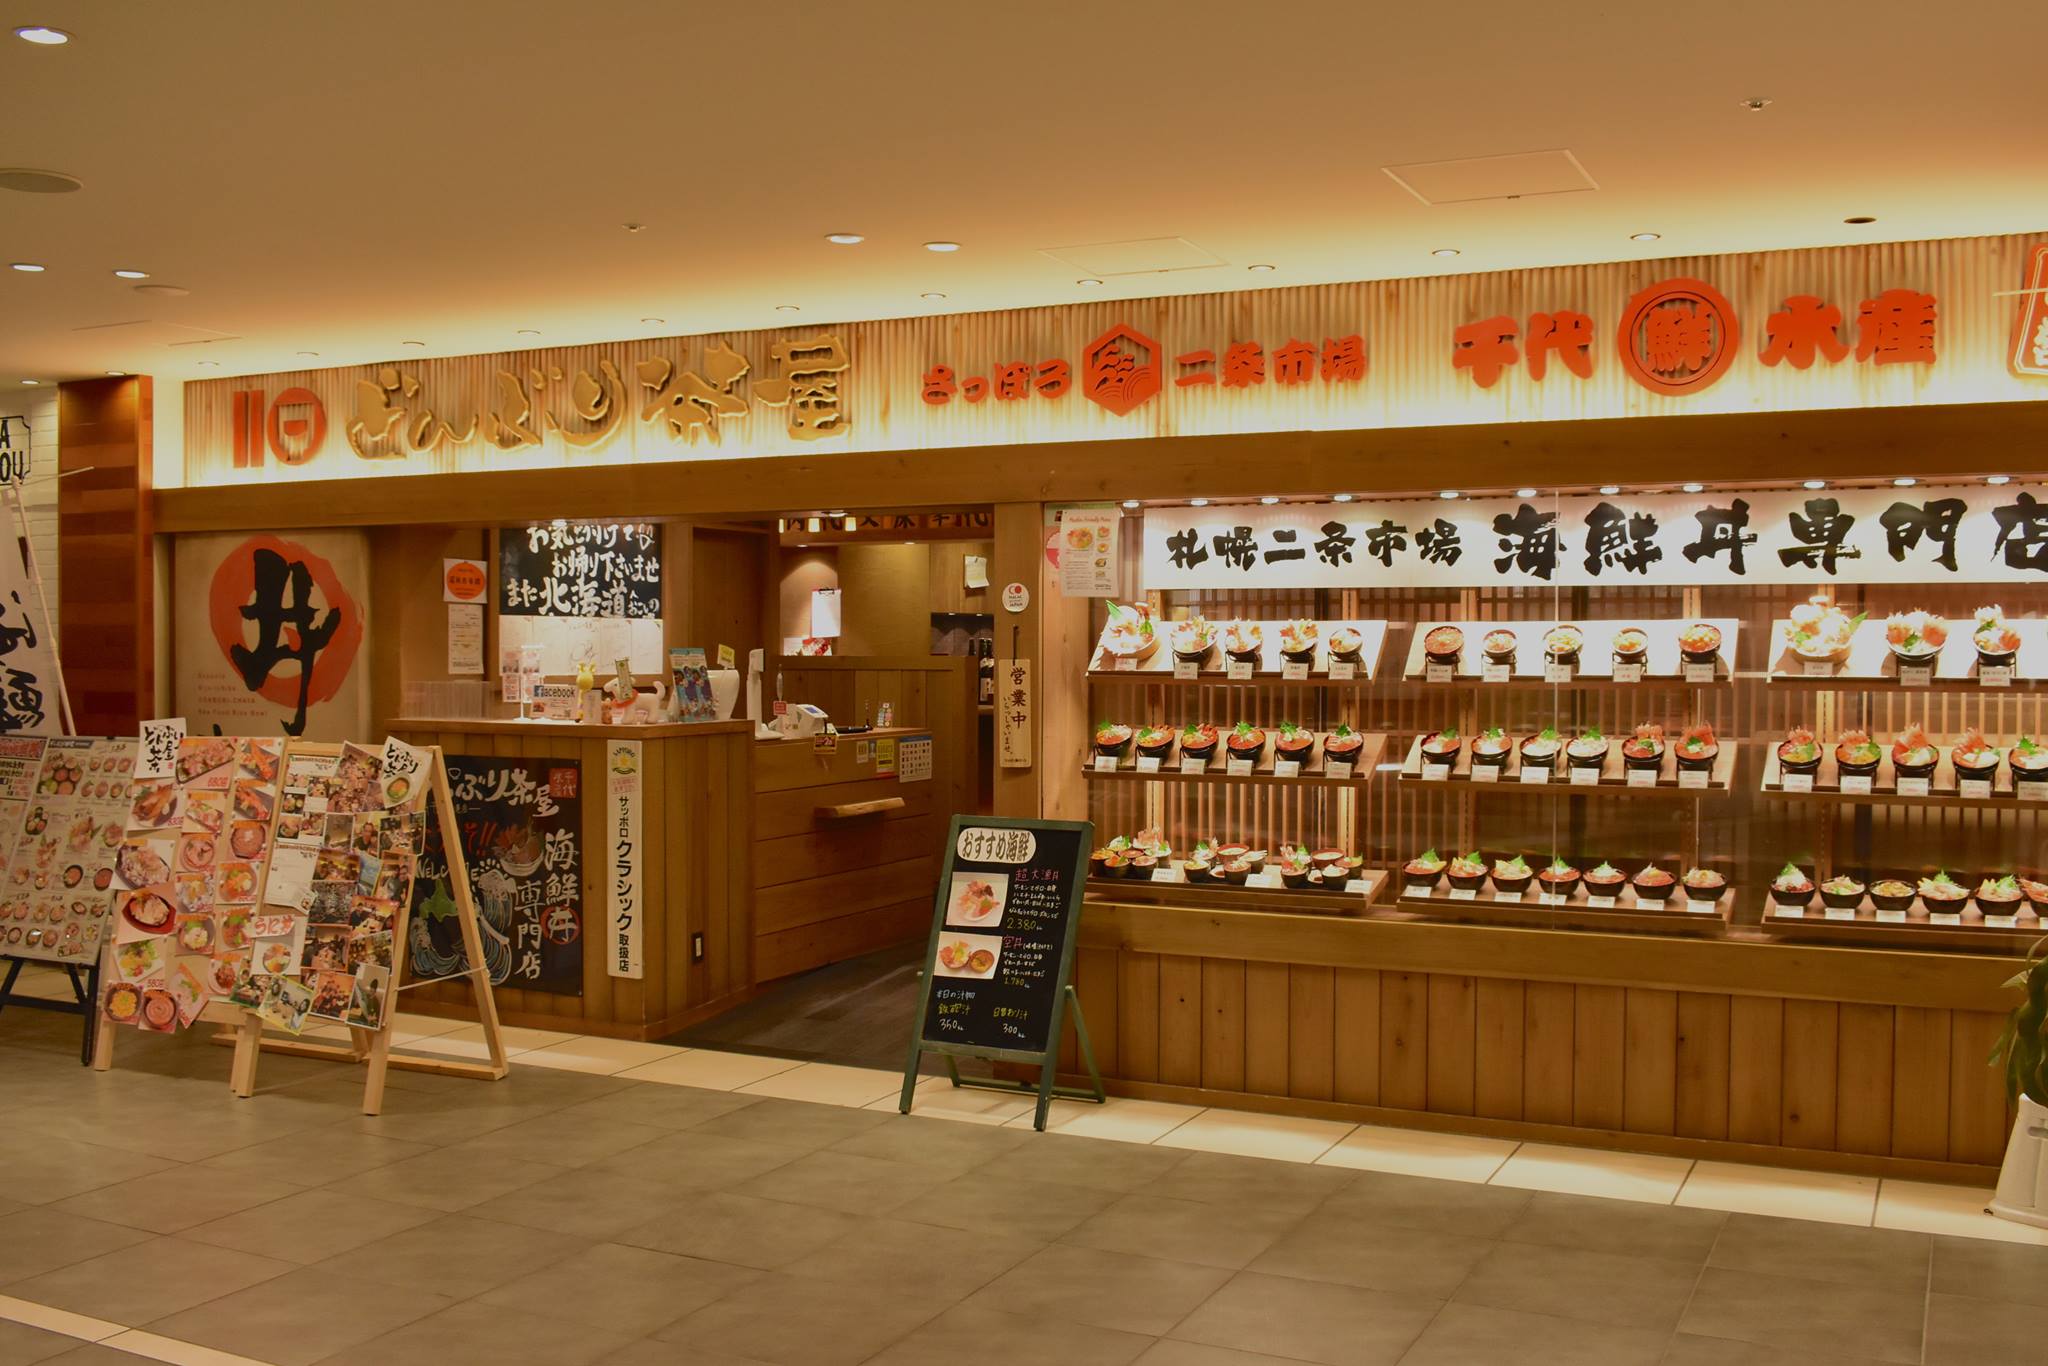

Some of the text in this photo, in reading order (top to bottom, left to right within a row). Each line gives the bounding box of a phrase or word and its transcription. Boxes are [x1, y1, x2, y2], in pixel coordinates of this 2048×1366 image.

[921, 334, 1367, 405] さっぽろ 二条市場
[1453, 310, 1595, 389] 千代
[1757, 289, 1939, 369] 水産
[345, 334, 851, 461] どんぶり茶屋
[1166, 518, 1464, 571] 札幌二条市場
[1010, 667, 1027, 729] 営業中
[544, 828, 580, 941] 海鮮丼
[616, 795, 633, 972] サッポロクラシック取扱店
[962, 830, 1031, 862] おすすめ海鮮
[514, 880, 546, 979] 専門店
